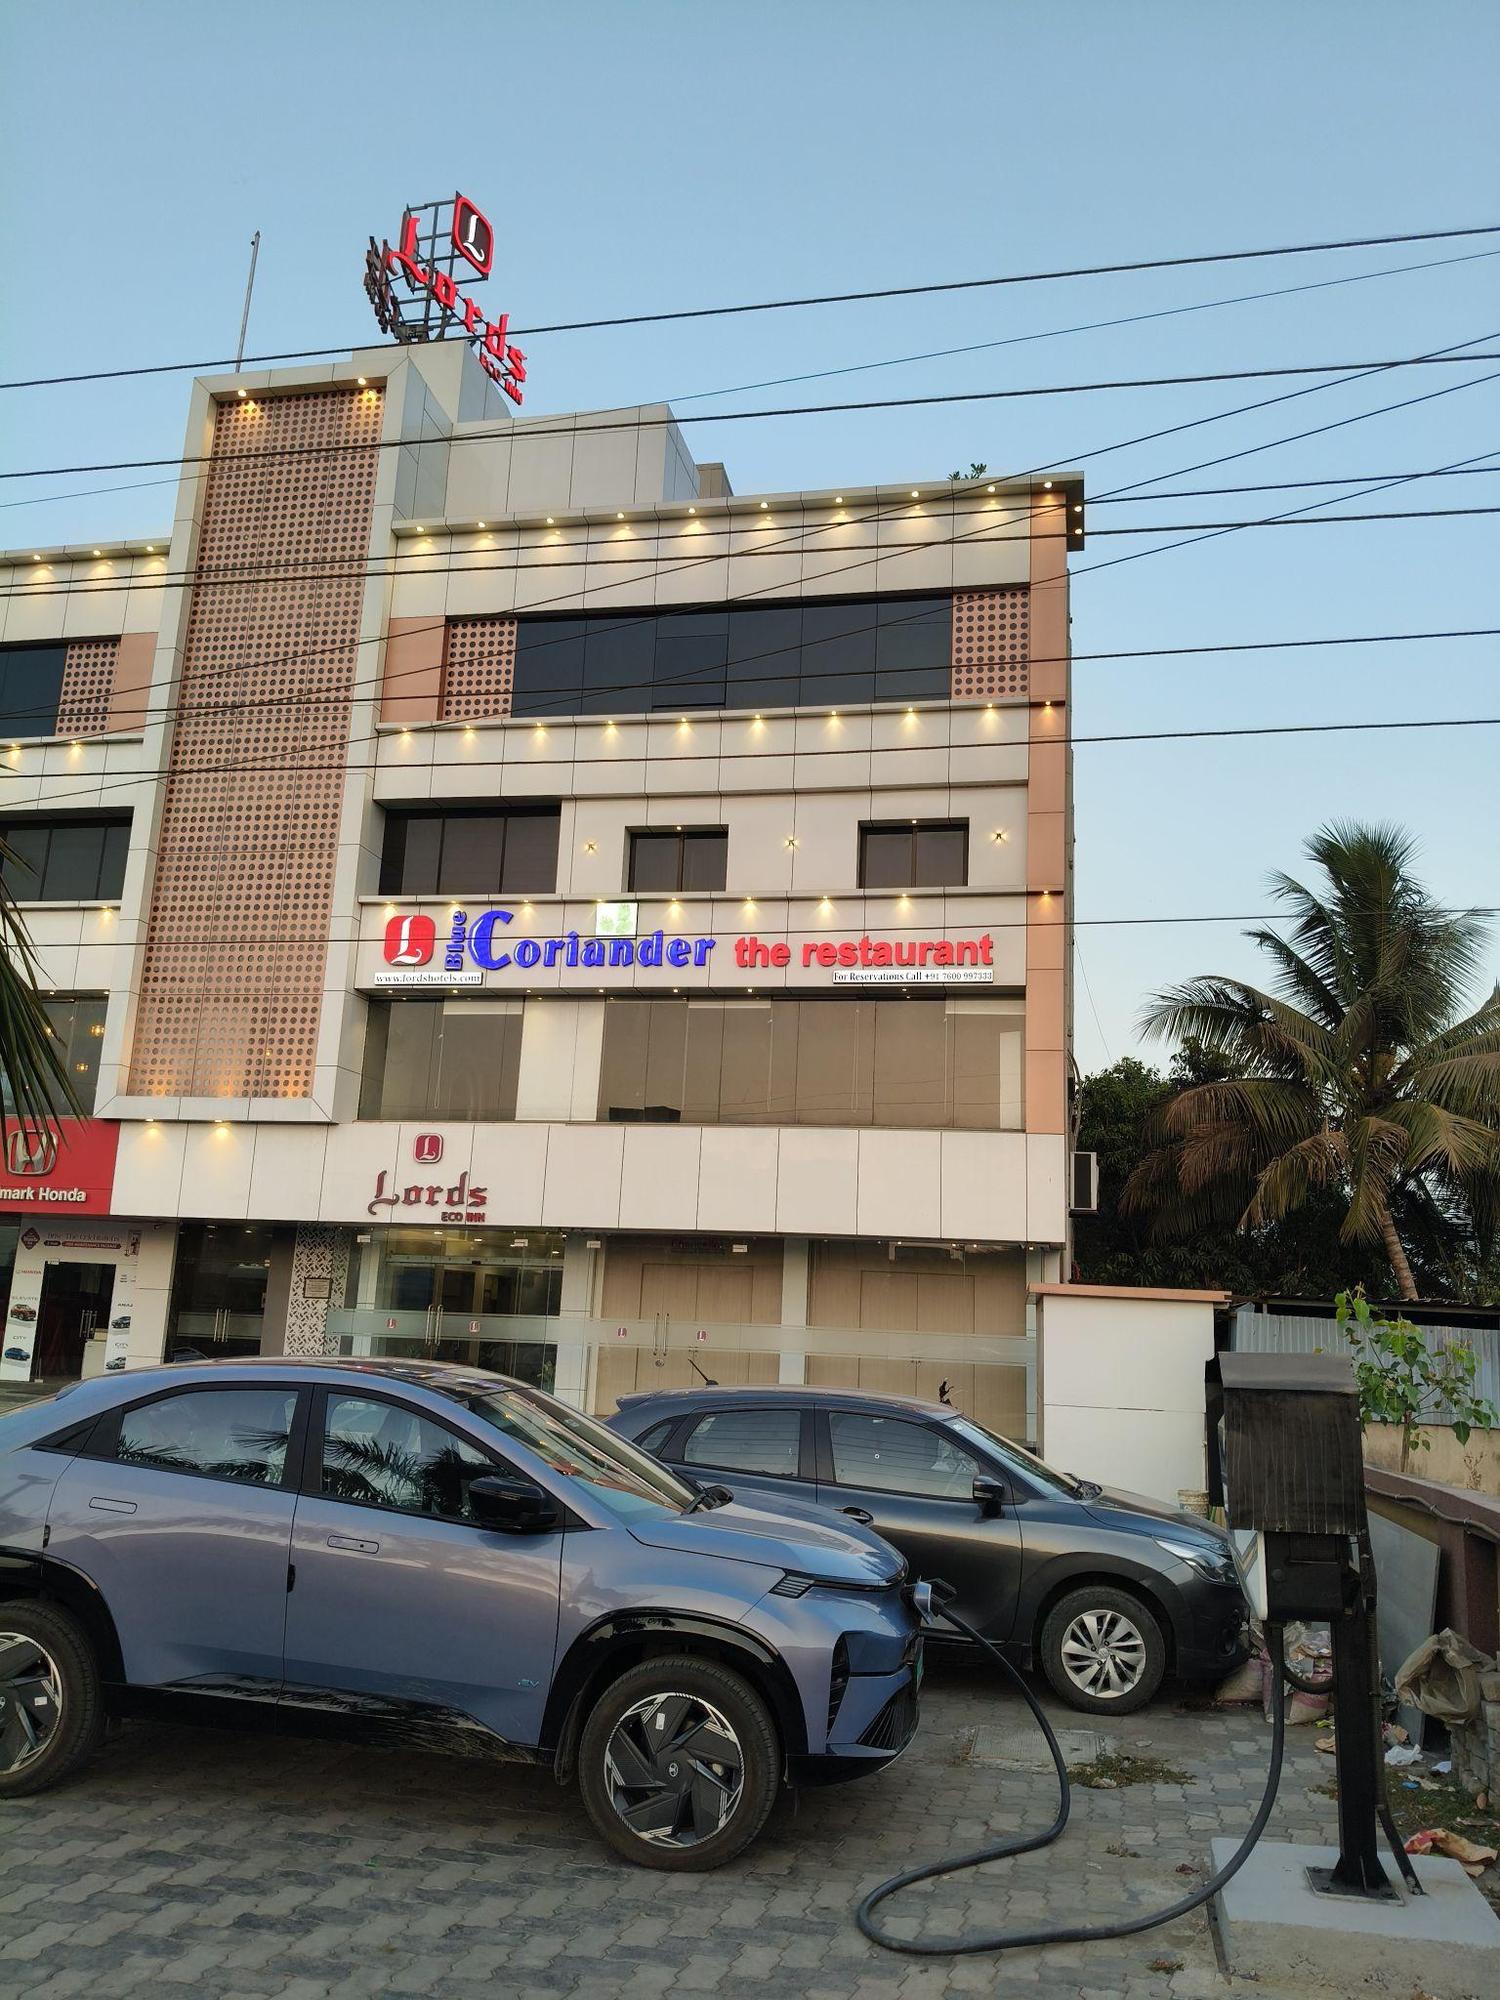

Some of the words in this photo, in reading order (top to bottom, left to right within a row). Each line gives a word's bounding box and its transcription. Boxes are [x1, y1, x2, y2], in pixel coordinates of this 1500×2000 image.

[386, 217, 527, 382] Lords
[388, 915, 424, 965] L
[444, 909, 468, 971] Blue
[468, 909, 717, 971] Coriander
[734, 936, 791, 968] the
[802, 932, 994, 968] restaurant
[833, 972, 848, 981] For
[850, 972, 904, 981] Reservations
[905, 971, 922, 981] Call
[417, 1136, 440, 1161] L
[0, 1186, 34, 1201] mark
[39, 1186, 87, 1202] Honda
[368, 1170, 488, 1215] Lords
[441, 1212, 464, 1222] ECO
